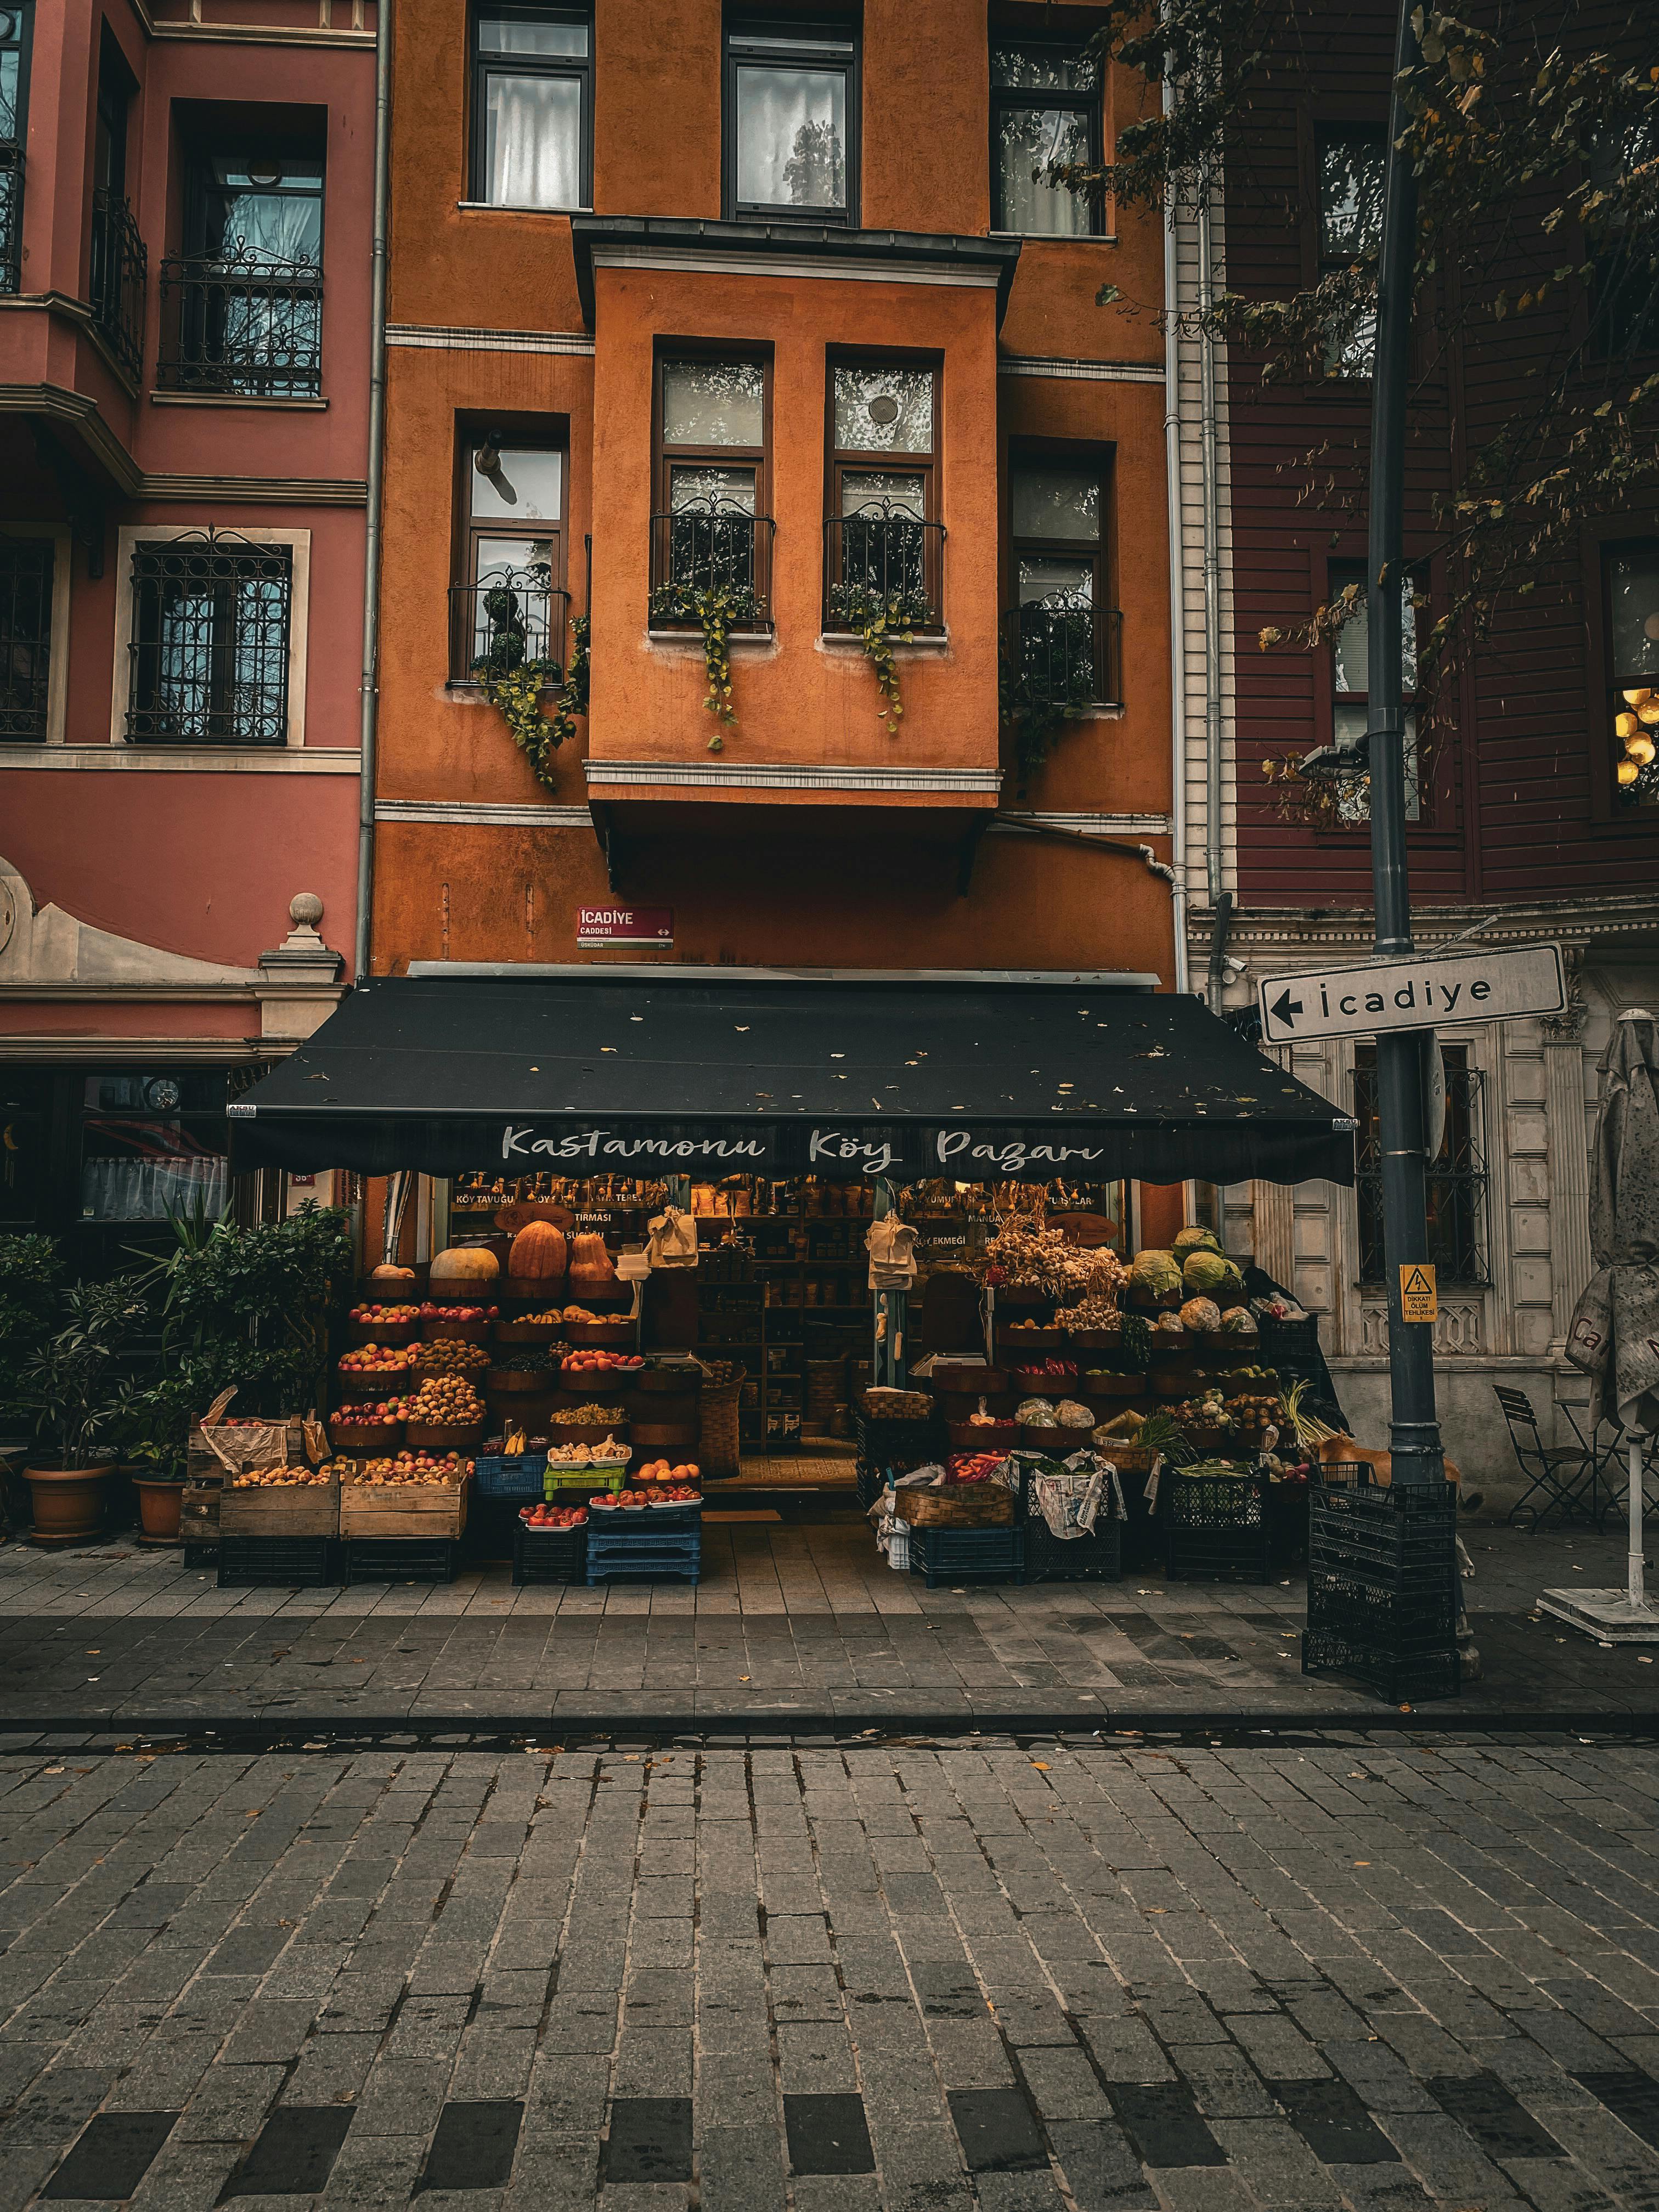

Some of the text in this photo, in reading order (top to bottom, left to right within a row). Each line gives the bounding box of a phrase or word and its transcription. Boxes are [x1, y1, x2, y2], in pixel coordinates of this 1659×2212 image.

[582, 910, 633, 924] İCADİYE
[1319, 980, 1492, 1018] İcadiye
[503, 1126, 1104, 1173] Kastamonu Köy Pazarı
[456, 1194, 514, 1203] KÖY TAVUĞU
[933, 1235, 966, 1244] EKMEĞİ
